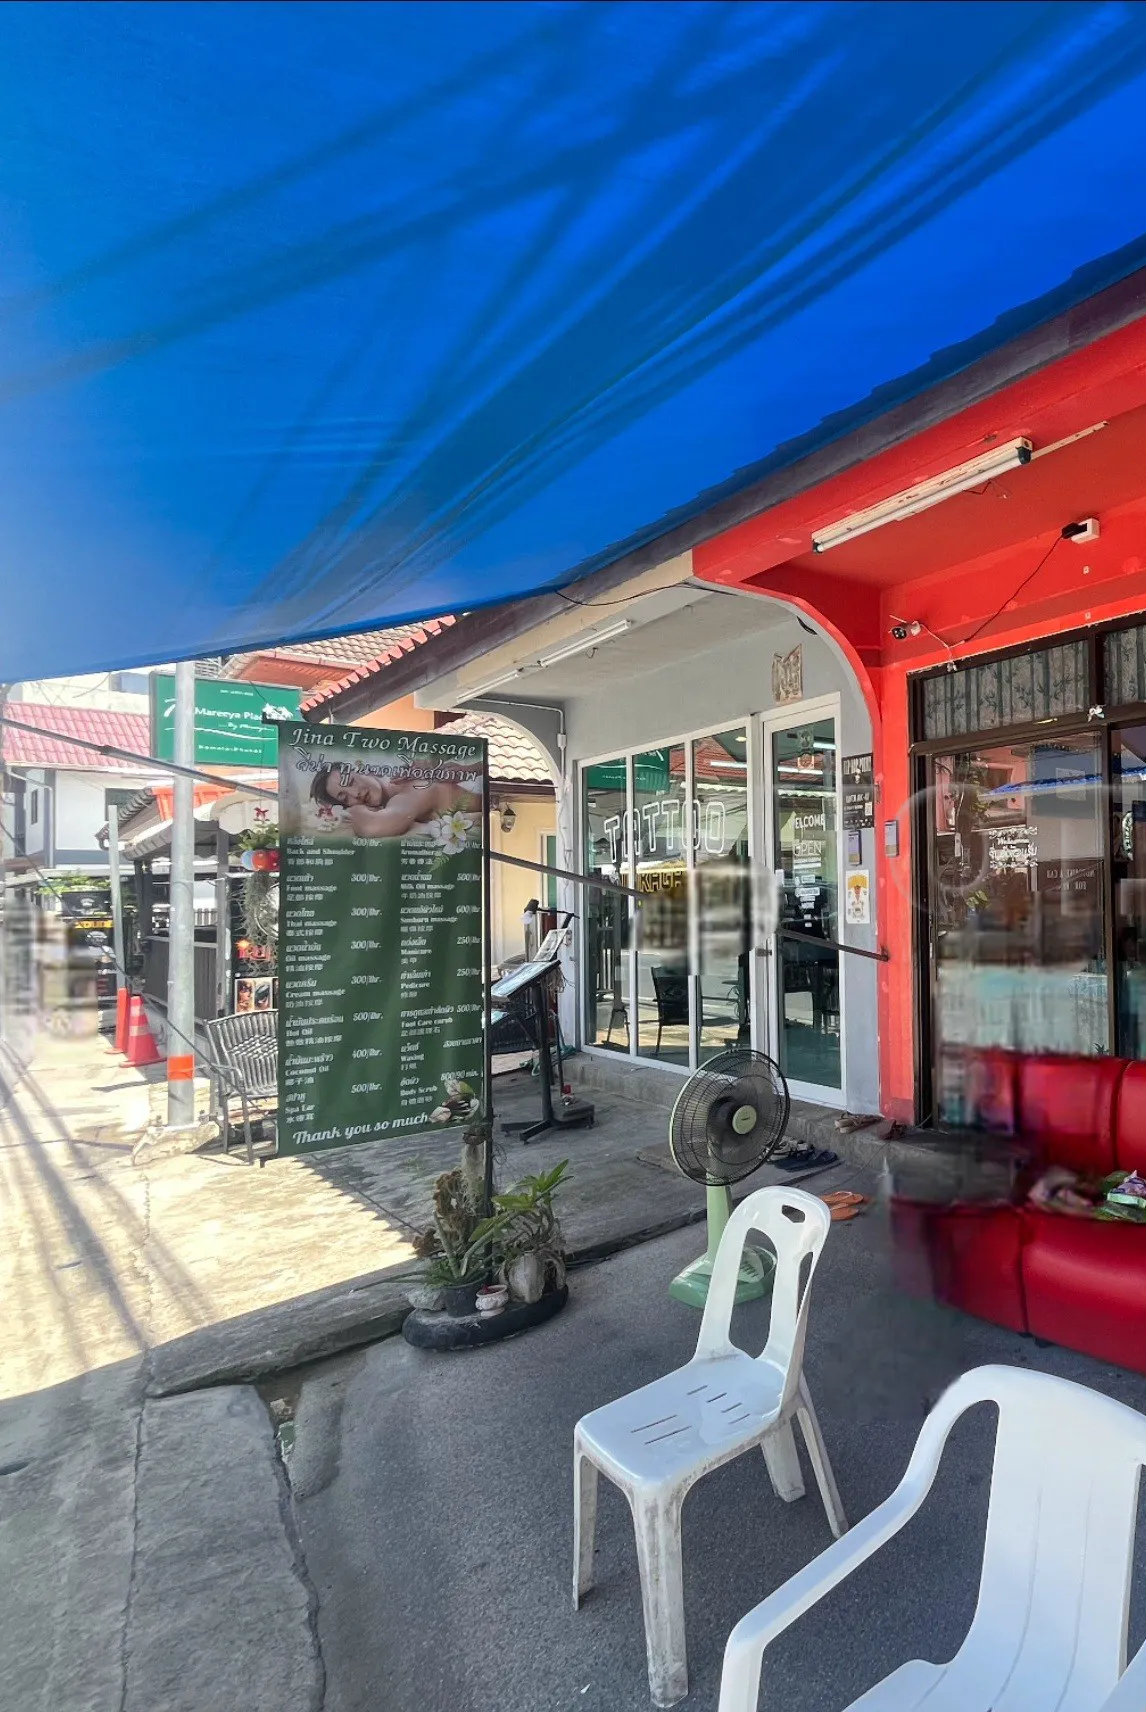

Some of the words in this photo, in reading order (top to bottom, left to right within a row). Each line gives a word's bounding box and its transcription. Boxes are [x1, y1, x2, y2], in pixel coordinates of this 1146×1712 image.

[194, 707, 240, 719] Mareeya
[288, 728, 334, 746] Jina
[343, 731, 390, 750] Two
[397, 736, 476, 760] Massage
[603, 799, 725, 863] TATTOO
[292, 1126, 342, 1144] Thank
[344, 1124, 372, 1140] you
[374, 1120, 390, 1132] so
[392, 1112, 428, 1128] much
